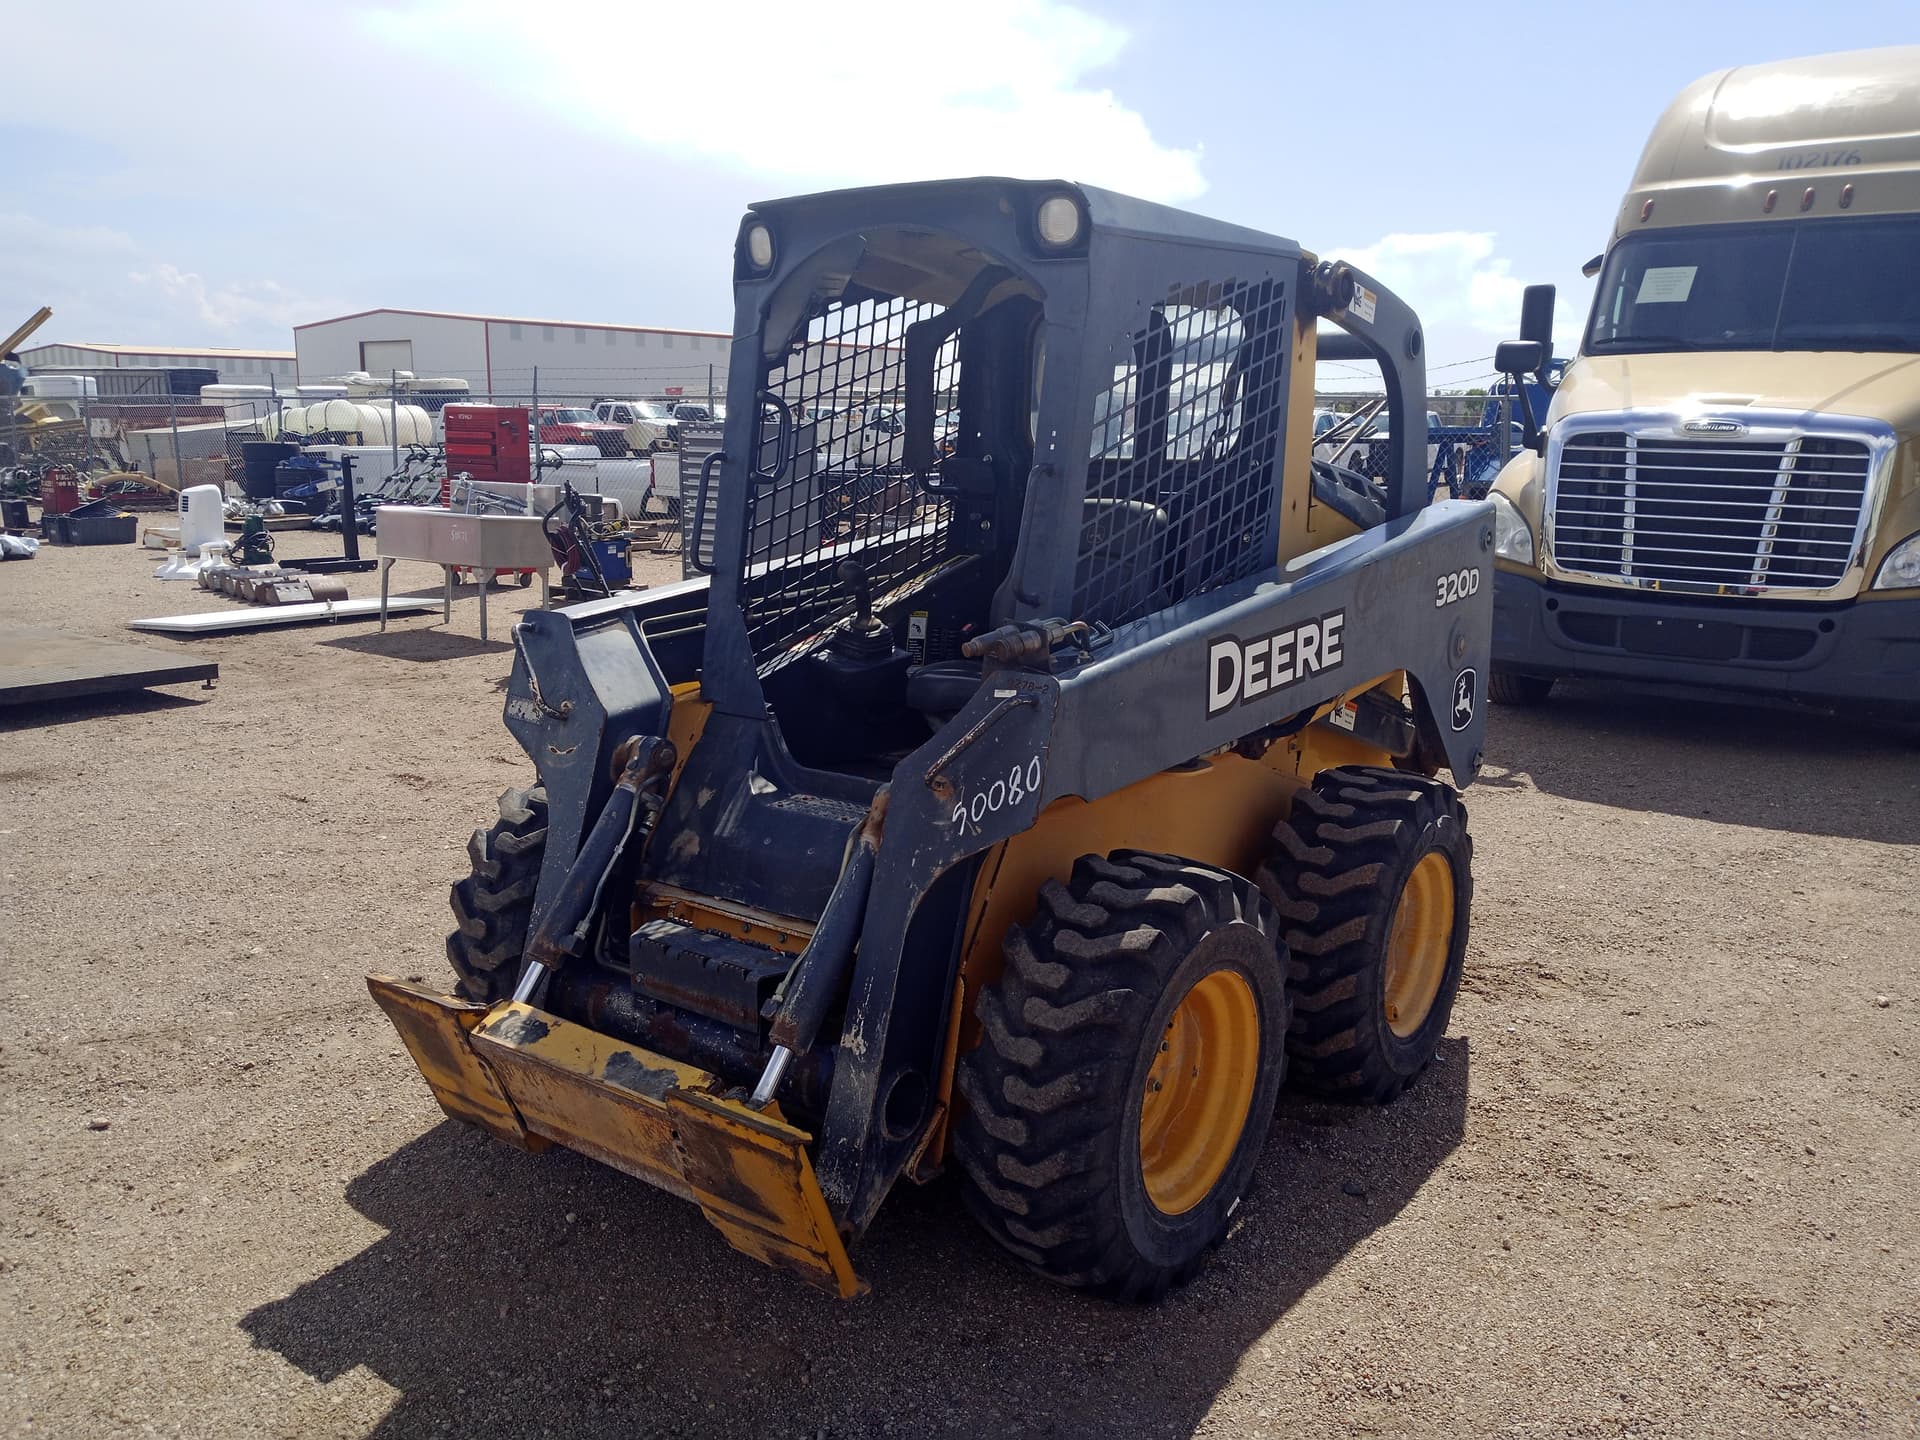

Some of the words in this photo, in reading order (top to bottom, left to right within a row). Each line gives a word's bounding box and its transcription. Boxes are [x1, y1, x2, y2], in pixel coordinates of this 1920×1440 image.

[1776, 148, 1863, 171] 102176
[1436, 568, 1480, 607] 320D
[1208, 612, 1344, 714] DEERE
[952, 755, 1040, 836] 50080
